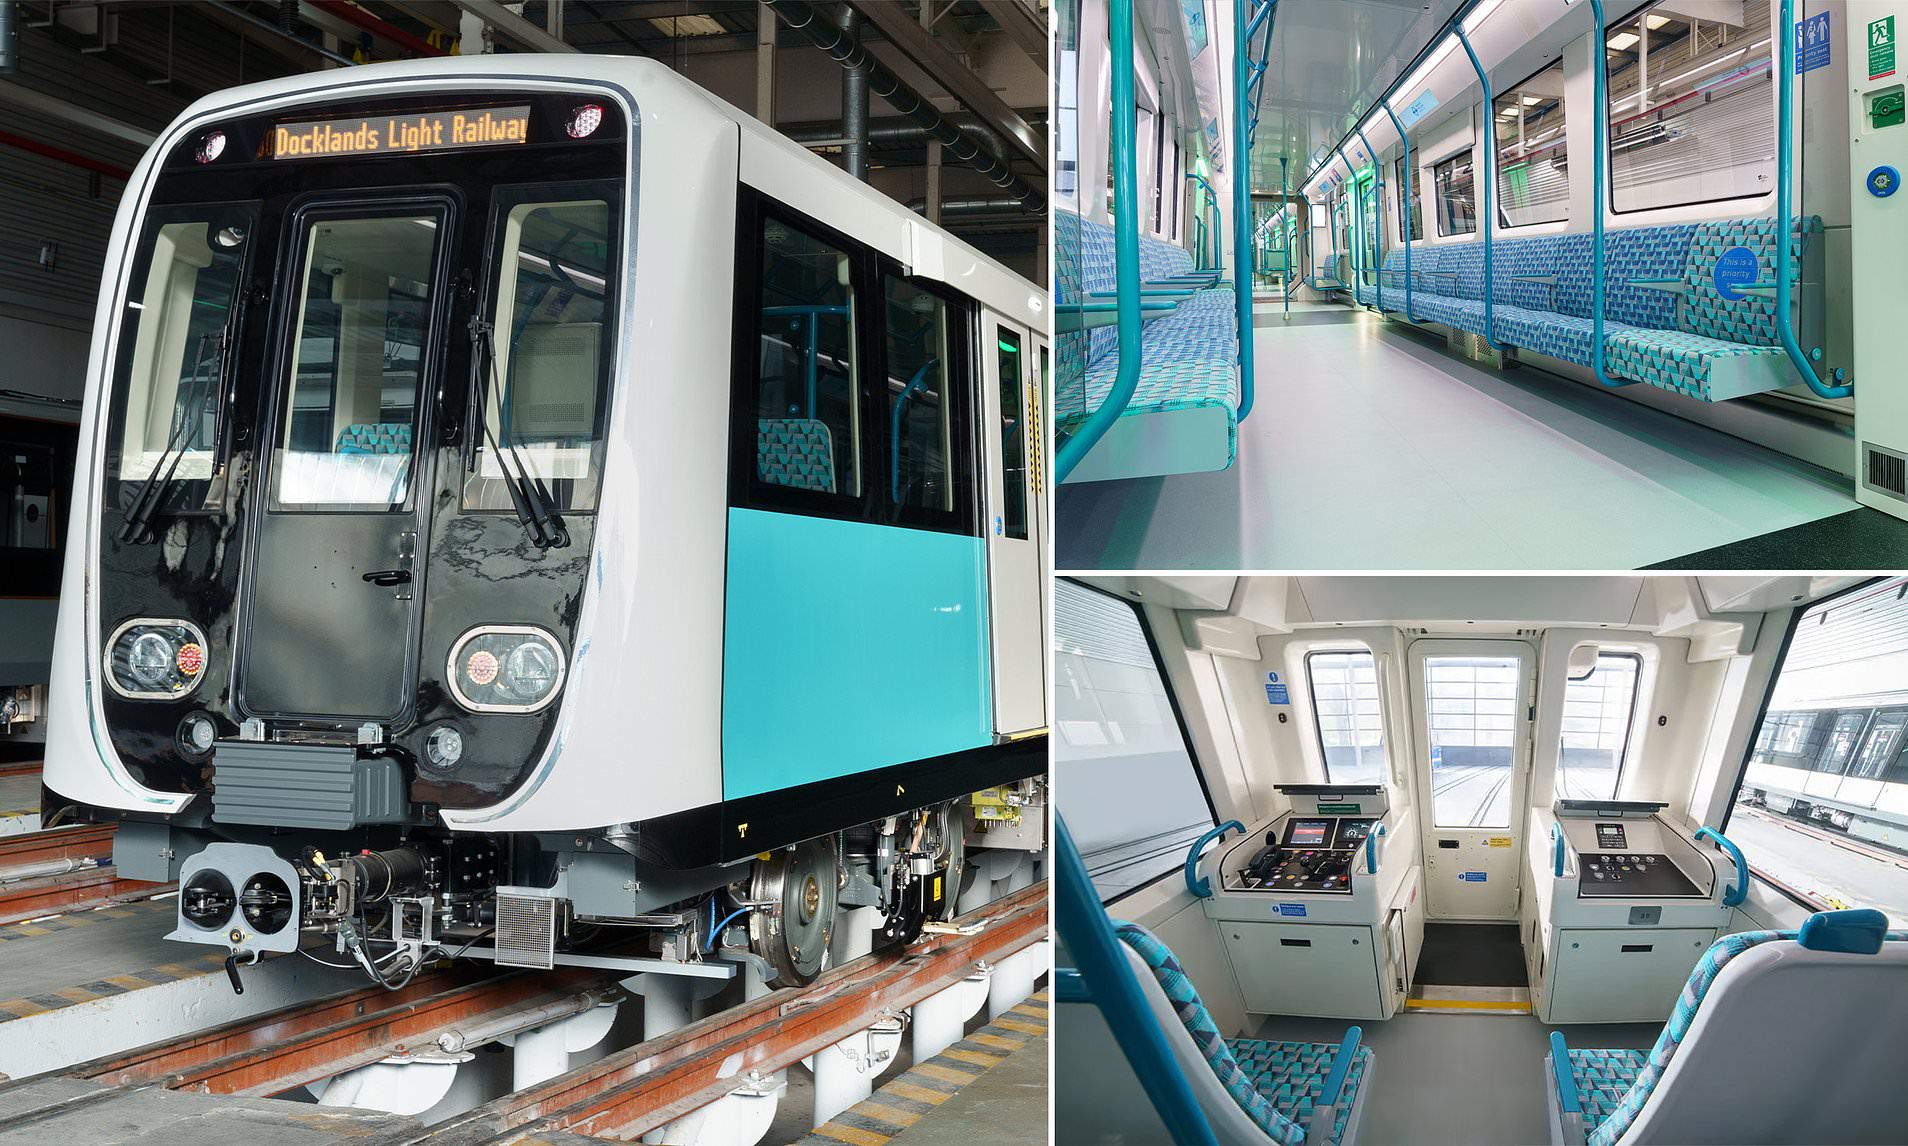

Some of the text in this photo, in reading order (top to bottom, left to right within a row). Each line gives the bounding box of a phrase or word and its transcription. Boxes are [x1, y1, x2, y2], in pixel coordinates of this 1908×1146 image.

[277, 121, 379, 156] Docklands
[388, 117, 443, 151] Light
[1722, 270, 1750, 278] priority
